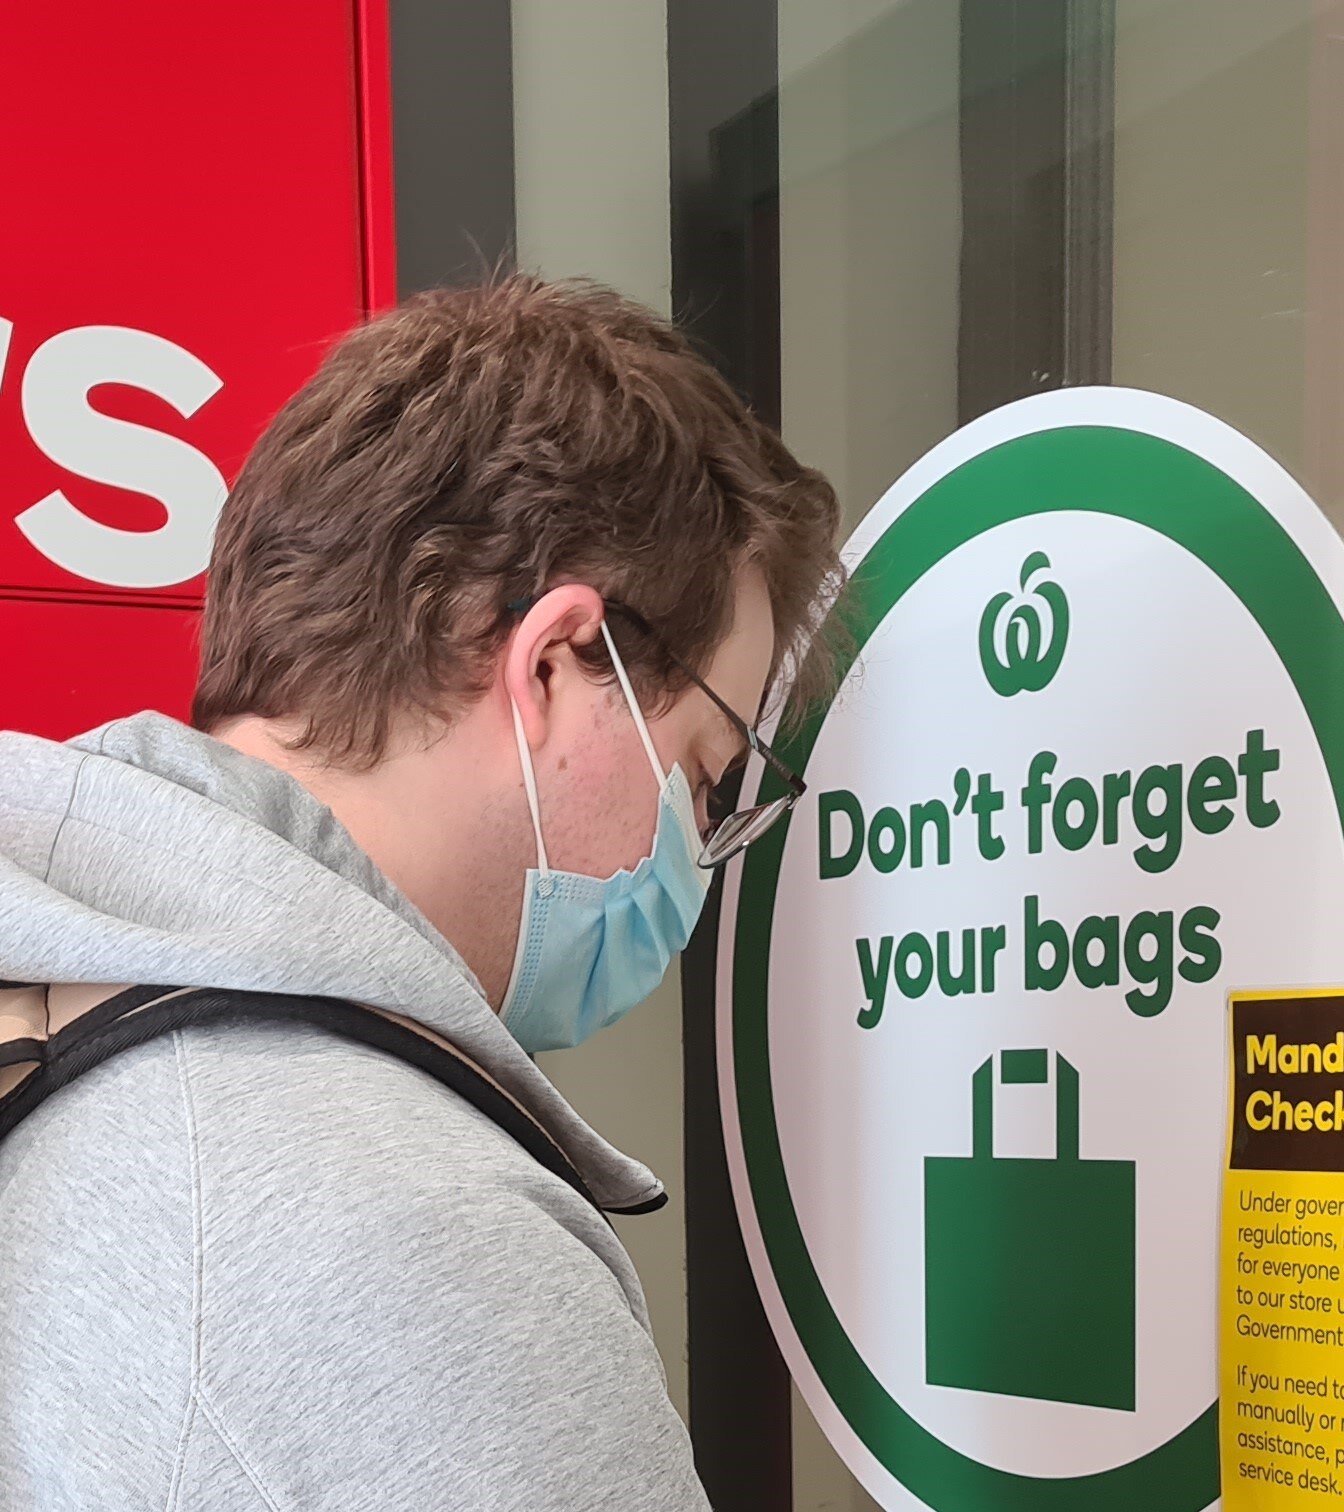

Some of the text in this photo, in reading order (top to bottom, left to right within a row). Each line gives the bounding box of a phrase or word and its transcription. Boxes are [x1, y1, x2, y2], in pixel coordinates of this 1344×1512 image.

[818, 729, 1282, 881] Don't forget
[856, 895, 1224, 1030] your bags
[1239, 1190, 1292, 1213] Under
[1238, 1223, 1337, 1251] regulations,
[1237, 1251, 1259, 1274] for
[1262, 1259, 1340, 1284] everyone
[1236, 1285, 1253, 1306] to
[1257, 1290, 1285, 1308] our
[1289, 1291, 1332, 1313] store
[1236, 1314, 1344, 1347] Government
[1237, 1365, 1248, 1386] If
[1249, 1372, 1280, 1393] you
[1284, 1376, 1327, 1398] need
[1237, 1400, 1315, 1433] manually
[1319, 1414, 1336, 1431] or
[1238, 1431, 1330, 1465] assistance,
[1239, 1461, 1343, 1496] service desk.
